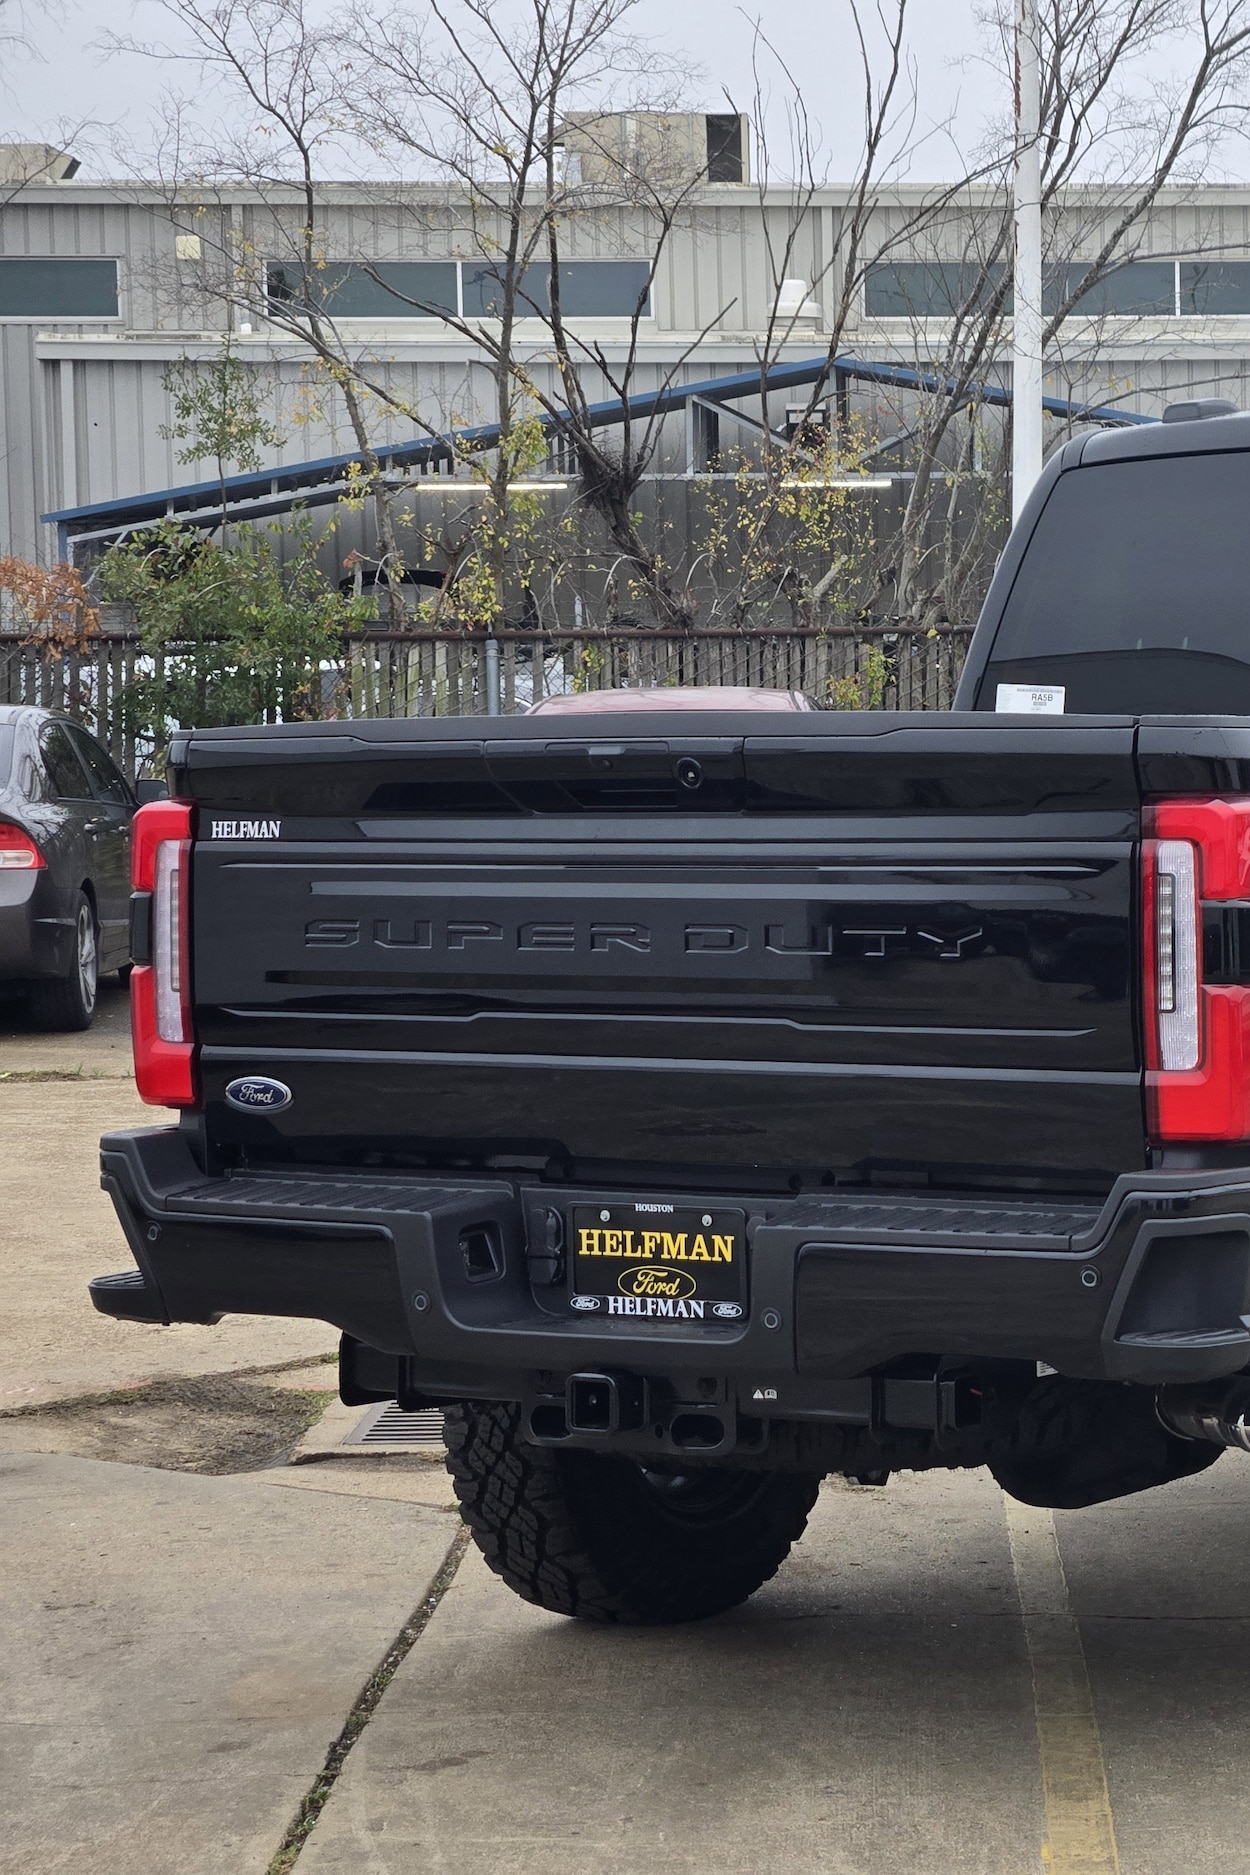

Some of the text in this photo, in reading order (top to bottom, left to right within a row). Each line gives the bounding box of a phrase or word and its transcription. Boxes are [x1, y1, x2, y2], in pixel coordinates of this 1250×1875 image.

[211, 820, 282, 839] HELFMAN
[304, 918, 985, 958] SUPER DUTY
[239, 1083, 274, 1103] Ford
[635, 1203, 674, 1213] HOUSTON
[578, 1228, 735, 1263] HELFMAN
[632, 1269, 681, 1296] Ford
[607, 1295, 705, 1319] HELFMAN
